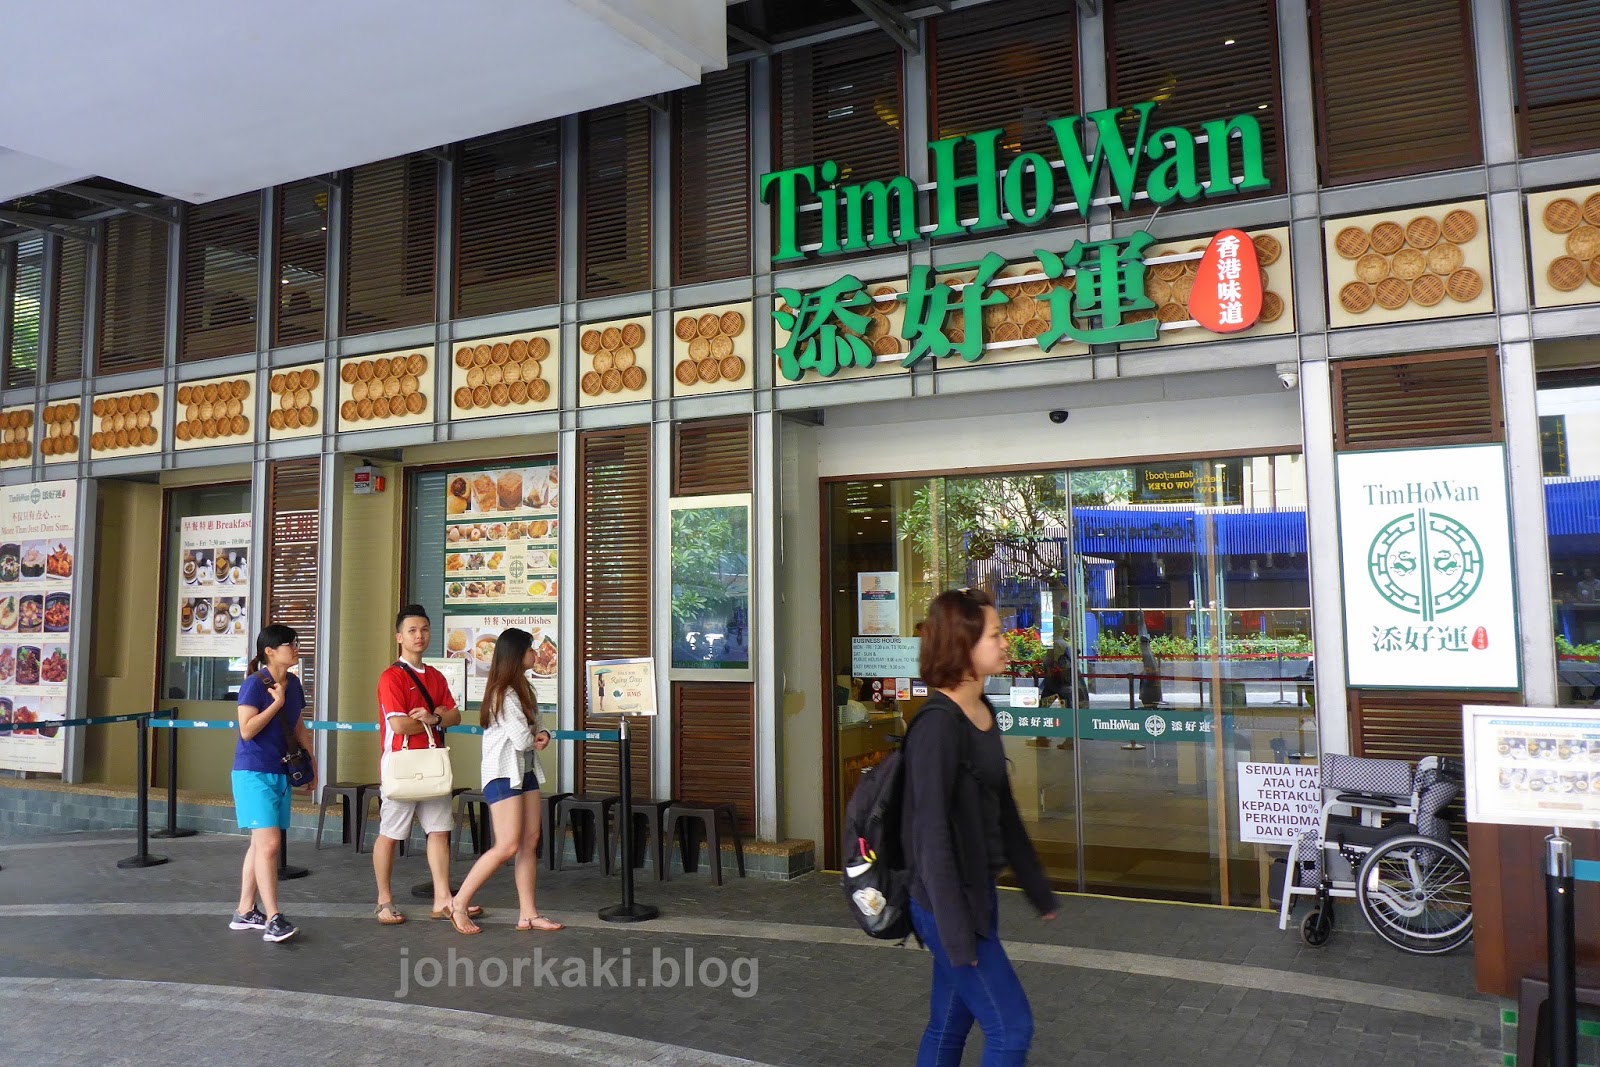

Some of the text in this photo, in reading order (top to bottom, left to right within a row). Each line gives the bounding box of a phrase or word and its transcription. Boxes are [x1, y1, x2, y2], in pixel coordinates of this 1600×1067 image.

[1216, 235, 1243, 325] 香港味道
[774, 230, 1160, 381] 添好運
[1363, 480, 1479, 505] TimHoWan
[28, 524, 39, 533] Just
[216, 518, 252, 530] Breakfast
[501, 617, 528, 627] Special
[528, 617, 551, 625] Dishes
[1372, 625, 1468, 652] 添好運
[610, 675, 643, 687] Rainy Days
[1018, 716, 1054, 728] 添好運
[1092, 718, 1211, 733] TimHoWan 添好運
[1245, 764, 1291, 776] SEMUA
[1262, 778, 1295, 788] ATAU
[1242, 800, 1319, 814] KEPADA 10%
[1245, 812, 1321, 826] PERKHIDMA
[1256, 825, 1282, 836] DAN
